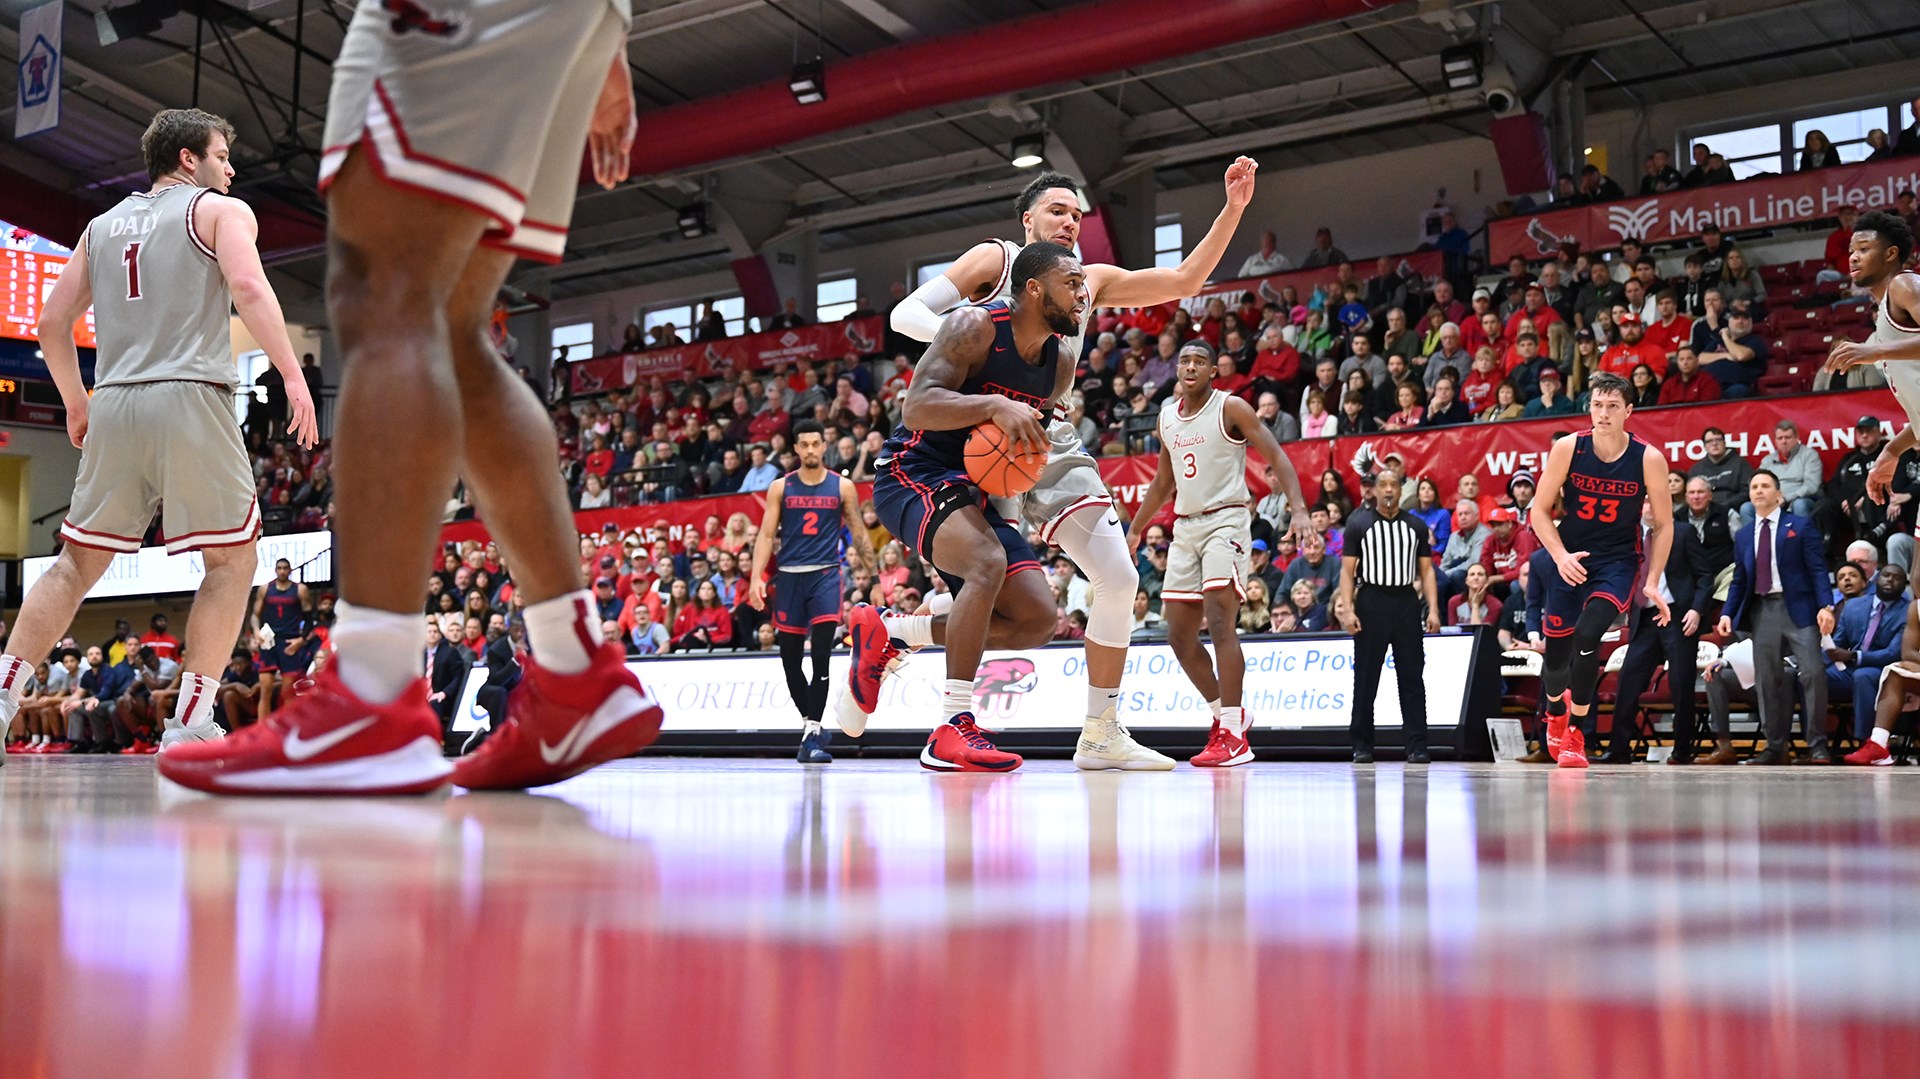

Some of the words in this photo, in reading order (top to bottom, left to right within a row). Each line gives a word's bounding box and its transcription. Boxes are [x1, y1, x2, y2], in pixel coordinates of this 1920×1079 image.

[109, 210, 163, 239] DALY
[1670, 202, 1741, 236] Main
[1749, 194, 1815, 225] Line
[122, 241, 144, 301] 1
[1172, 431, 1206, 450] Hawks
[1665, 440, 1706, 462] TO
[1724, 428, 1855, 457] HAAN
[1182, 451, 1198, 480] 3
[1112, 483, 1150, 504] EVE
[1572, 474, 1638, 496] FLYERS
[785, 496, 839, 509] FLYERS
[1576, 495, 1620, 523] 33
[802, 511, 819, 535] 2
[1129, 691, 1158, 712] St.
[1165, 691, 1207, 712] Joe
